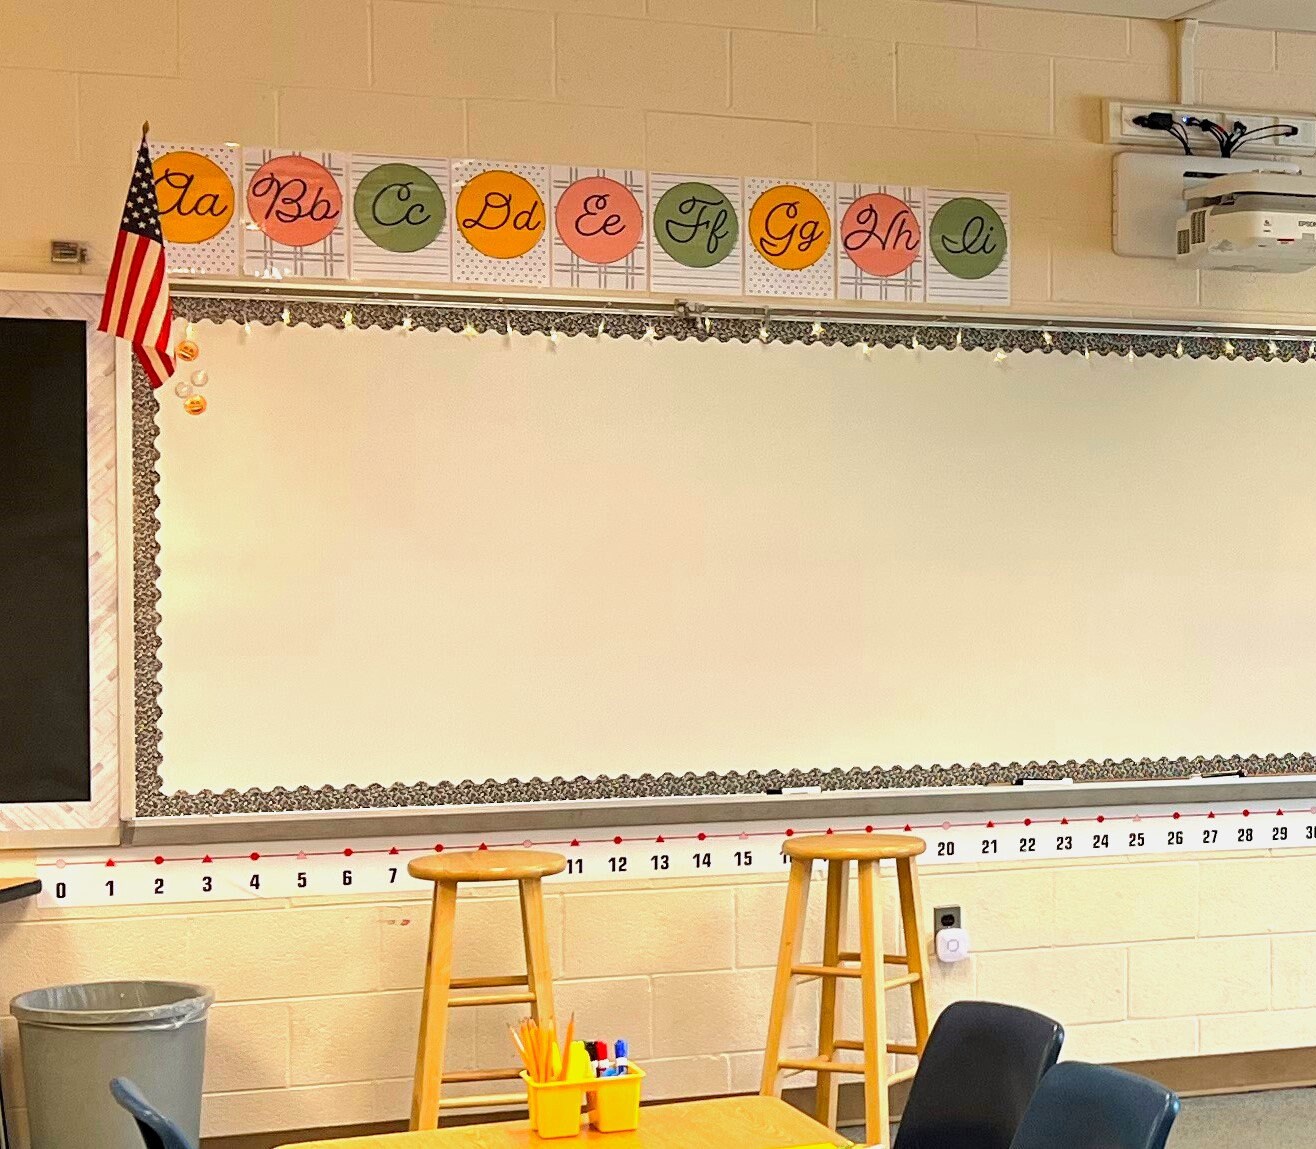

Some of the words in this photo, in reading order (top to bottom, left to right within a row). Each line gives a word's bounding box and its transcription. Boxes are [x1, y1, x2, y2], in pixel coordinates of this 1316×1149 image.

[157, 168, 228, 218] Aa
[251, 172, 339, 223] Bb
[371, 182, 431, 226] Cc
[462, 191, 541, 231] Dd
[575, 194, 626, 236] Ee
[665, 196, 728, 254] Ff
[759, 202, 824, 256] Gg
[843, 204, 919, 251] Hh
[941, 215, 997, 254] Ii
[56, 883, 66, 898] 0
[106, 881, 113, 896] 1
[155, 878, 163, 894] 2
[203, 877, 212, 892] 3
[250, 875, 259, 889] 4
[298, 872, 306, 887] 5
[343, 871, 352, 885] 6
[389, 868, 397, 883] 7
[567, 859, 582, 874] 11
[608, 857, 626, 872] 12
[651, 855, 669, 870] 13
[693, 853, 711, 868] 14
[734, 851, 752, 866] 15
[938, 842, 954, 856] 20
[982, 840, 996, 853] 21
[1020, 838, 1035, 852] 22
[1057, 836, 1072, 850] 23
[1093, 835, 1108, 848] 24
[1129, 833, 1144, 846] 25
[1168, 831, 1183, 845] 26
[1203, 830, 1217, 843] 27
[1238, 829, 1253, 841] 28
[1273, 827, 1287, 840] 29
